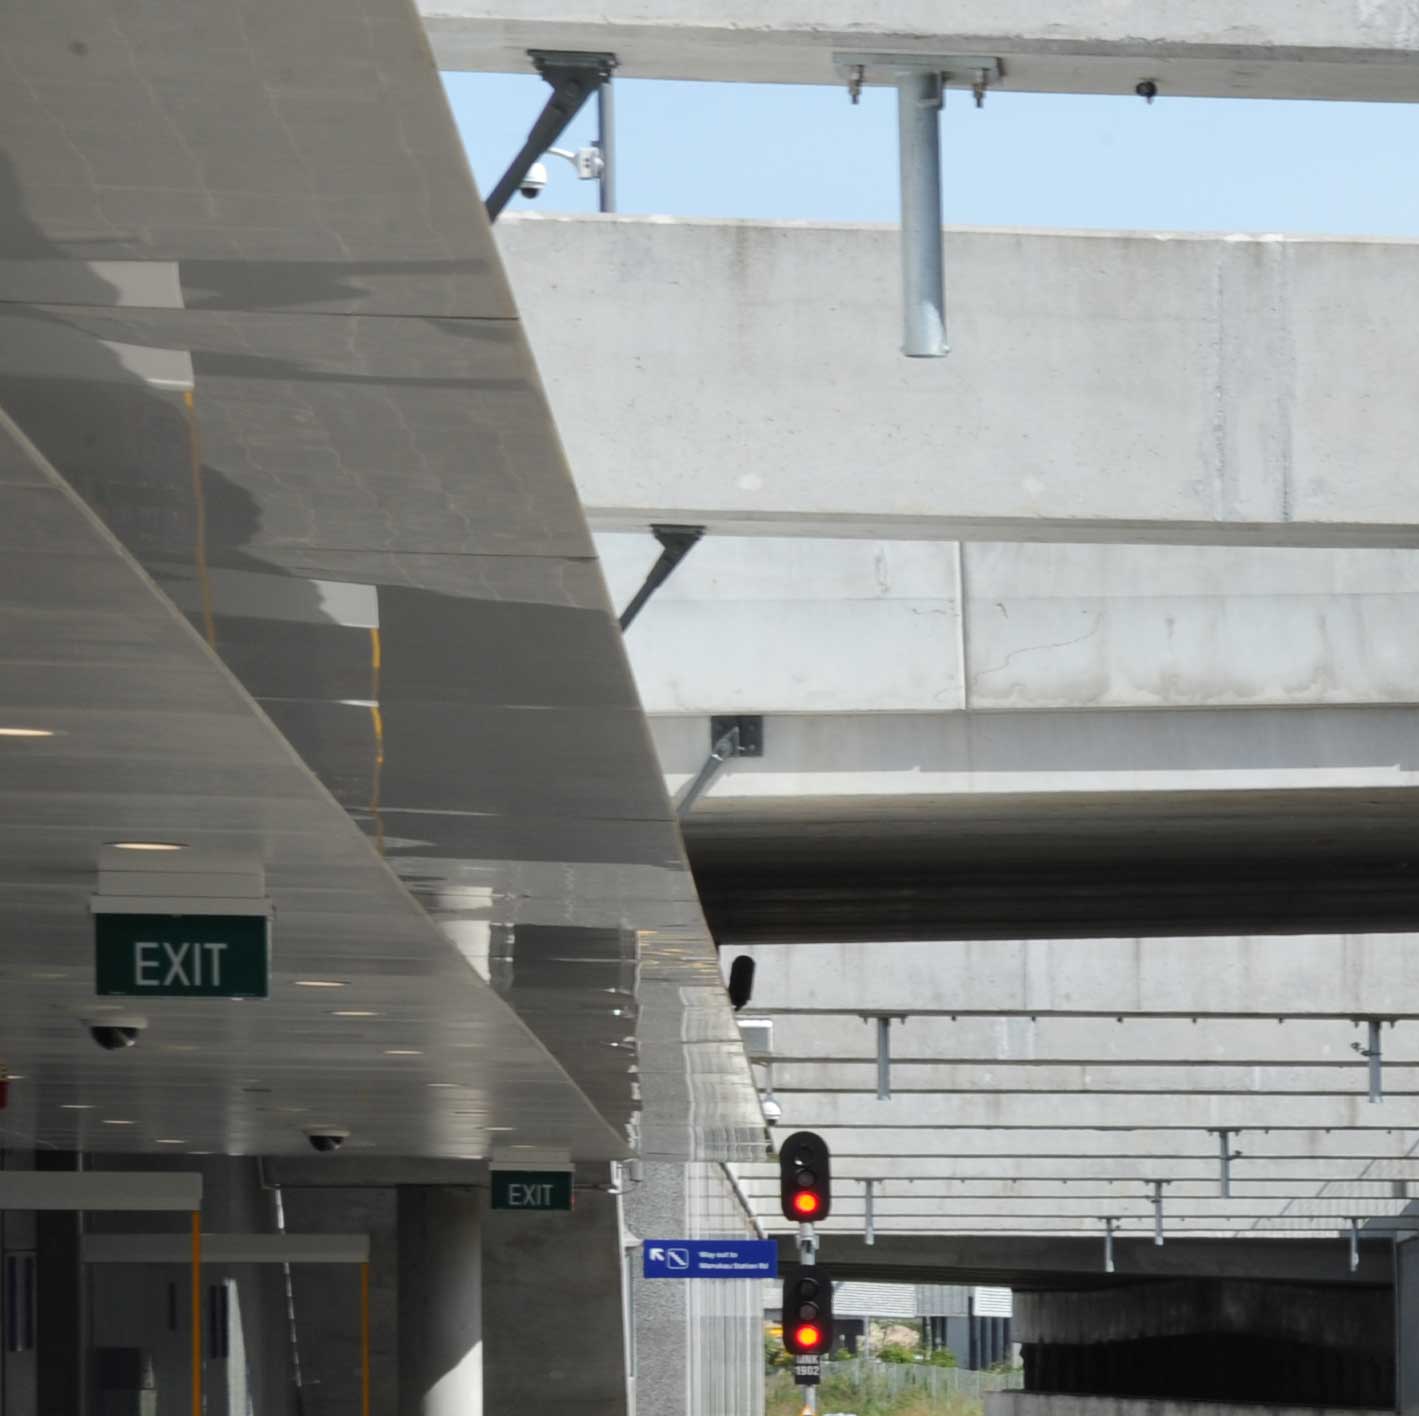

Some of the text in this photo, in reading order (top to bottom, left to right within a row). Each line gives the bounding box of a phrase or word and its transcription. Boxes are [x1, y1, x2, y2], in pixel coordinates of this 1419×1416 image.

[134, 941, 229, 987] EXIT
[508, 1184, 555, 1206] EXIT
[795, 1366, 820, 1375] 1902
